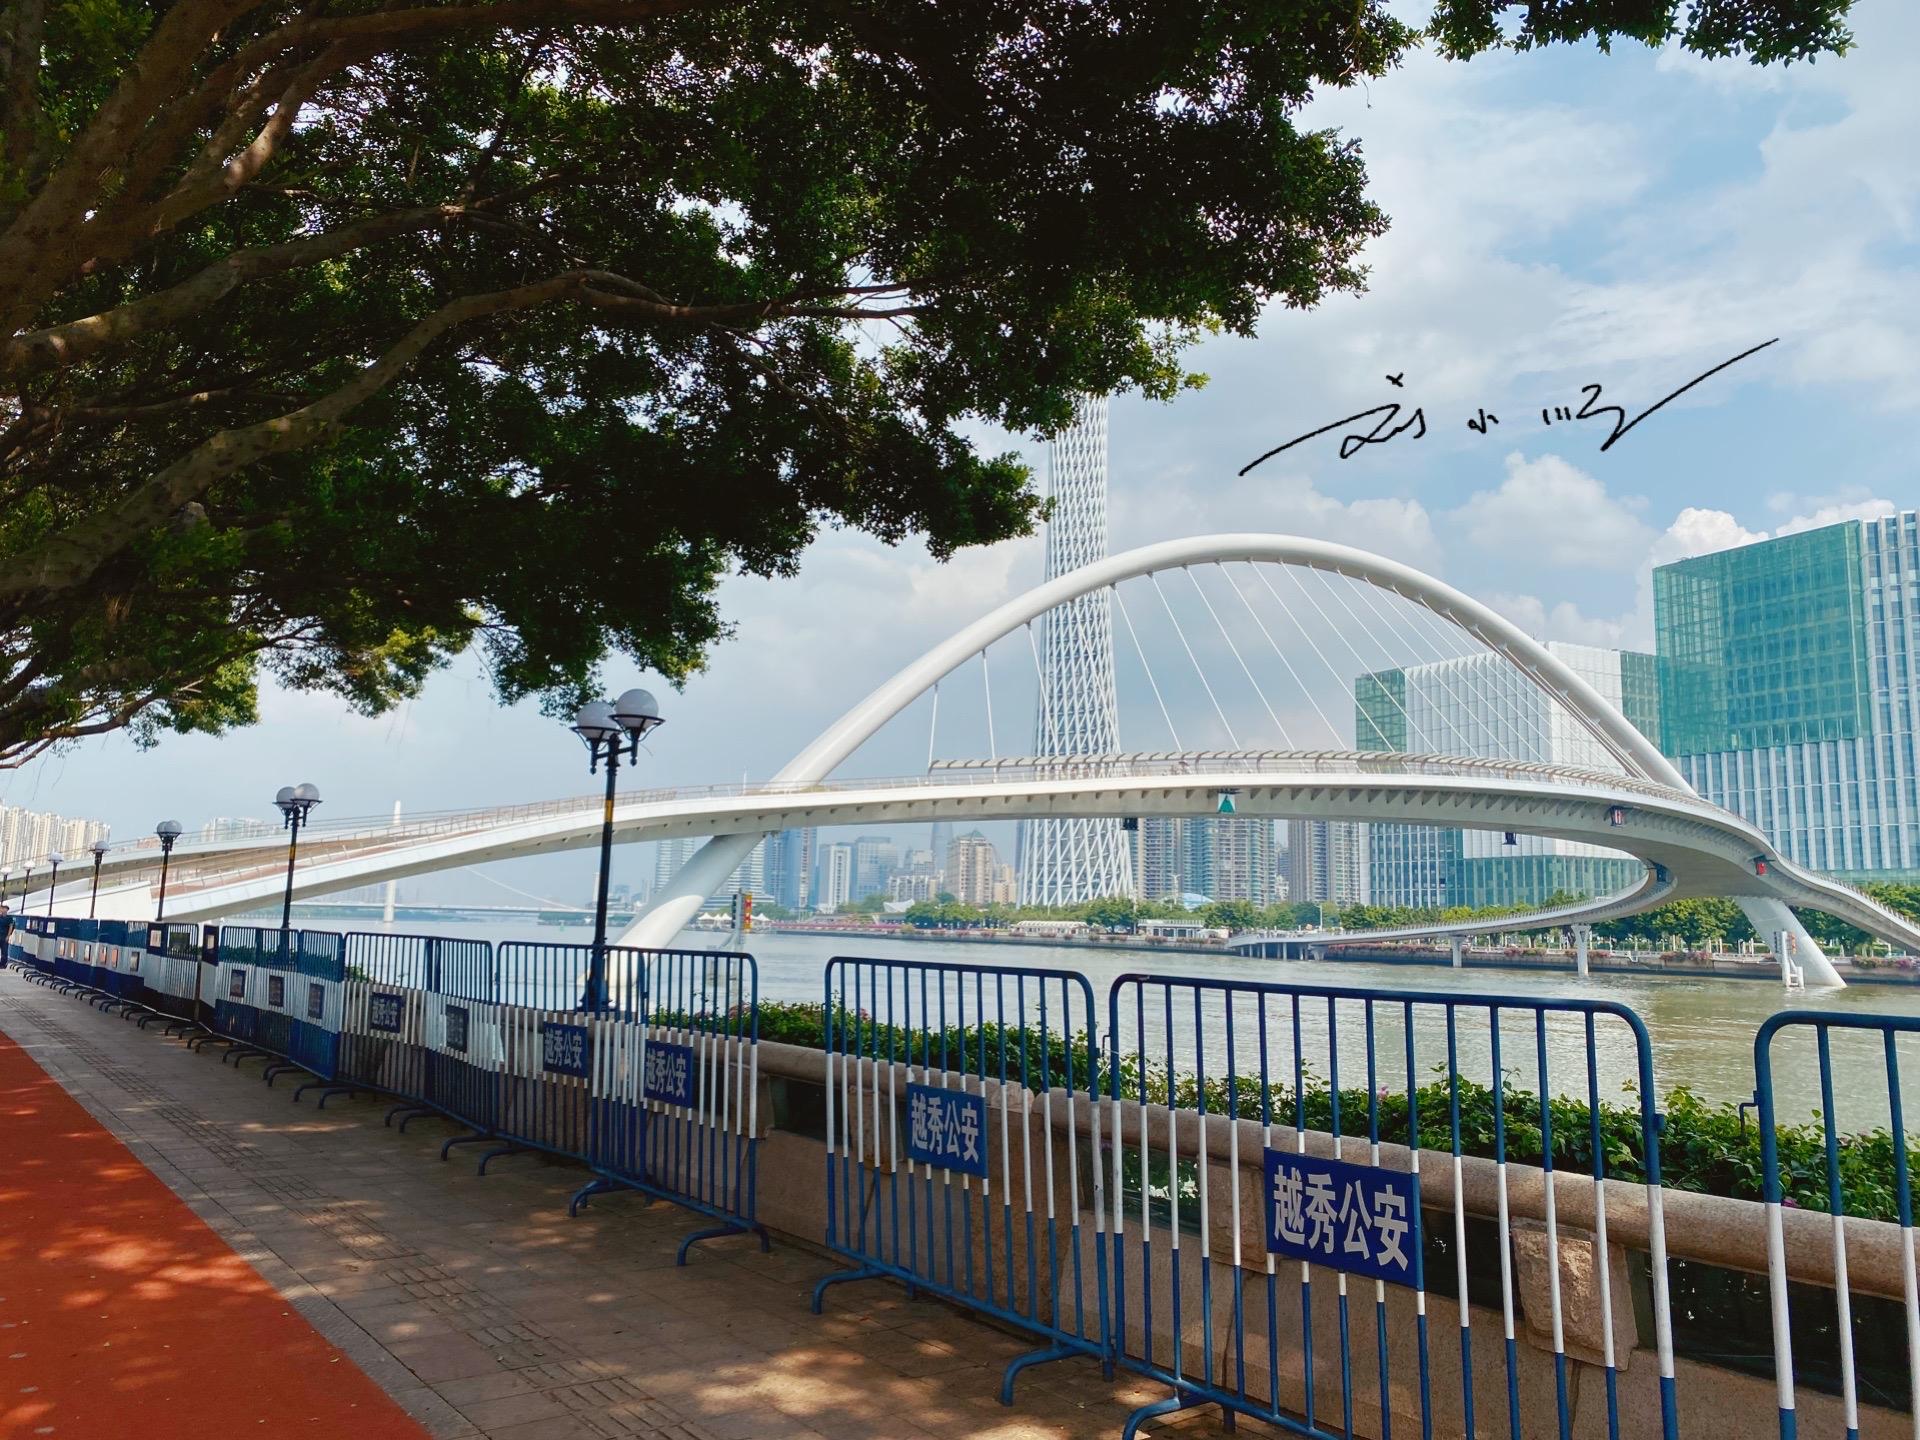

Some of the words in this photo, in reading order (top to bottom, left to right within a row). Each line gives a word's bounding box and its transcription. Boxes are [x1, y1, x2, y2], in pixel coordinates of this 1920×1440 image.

[544, 1026, 583, 1069] 越秀公安
[644, 1047, 686, 1098] 越秀公安
[910, 1092, 980, 1163] 越秀公安
[1272, 1164, 1410, 1271] 越秀公安
